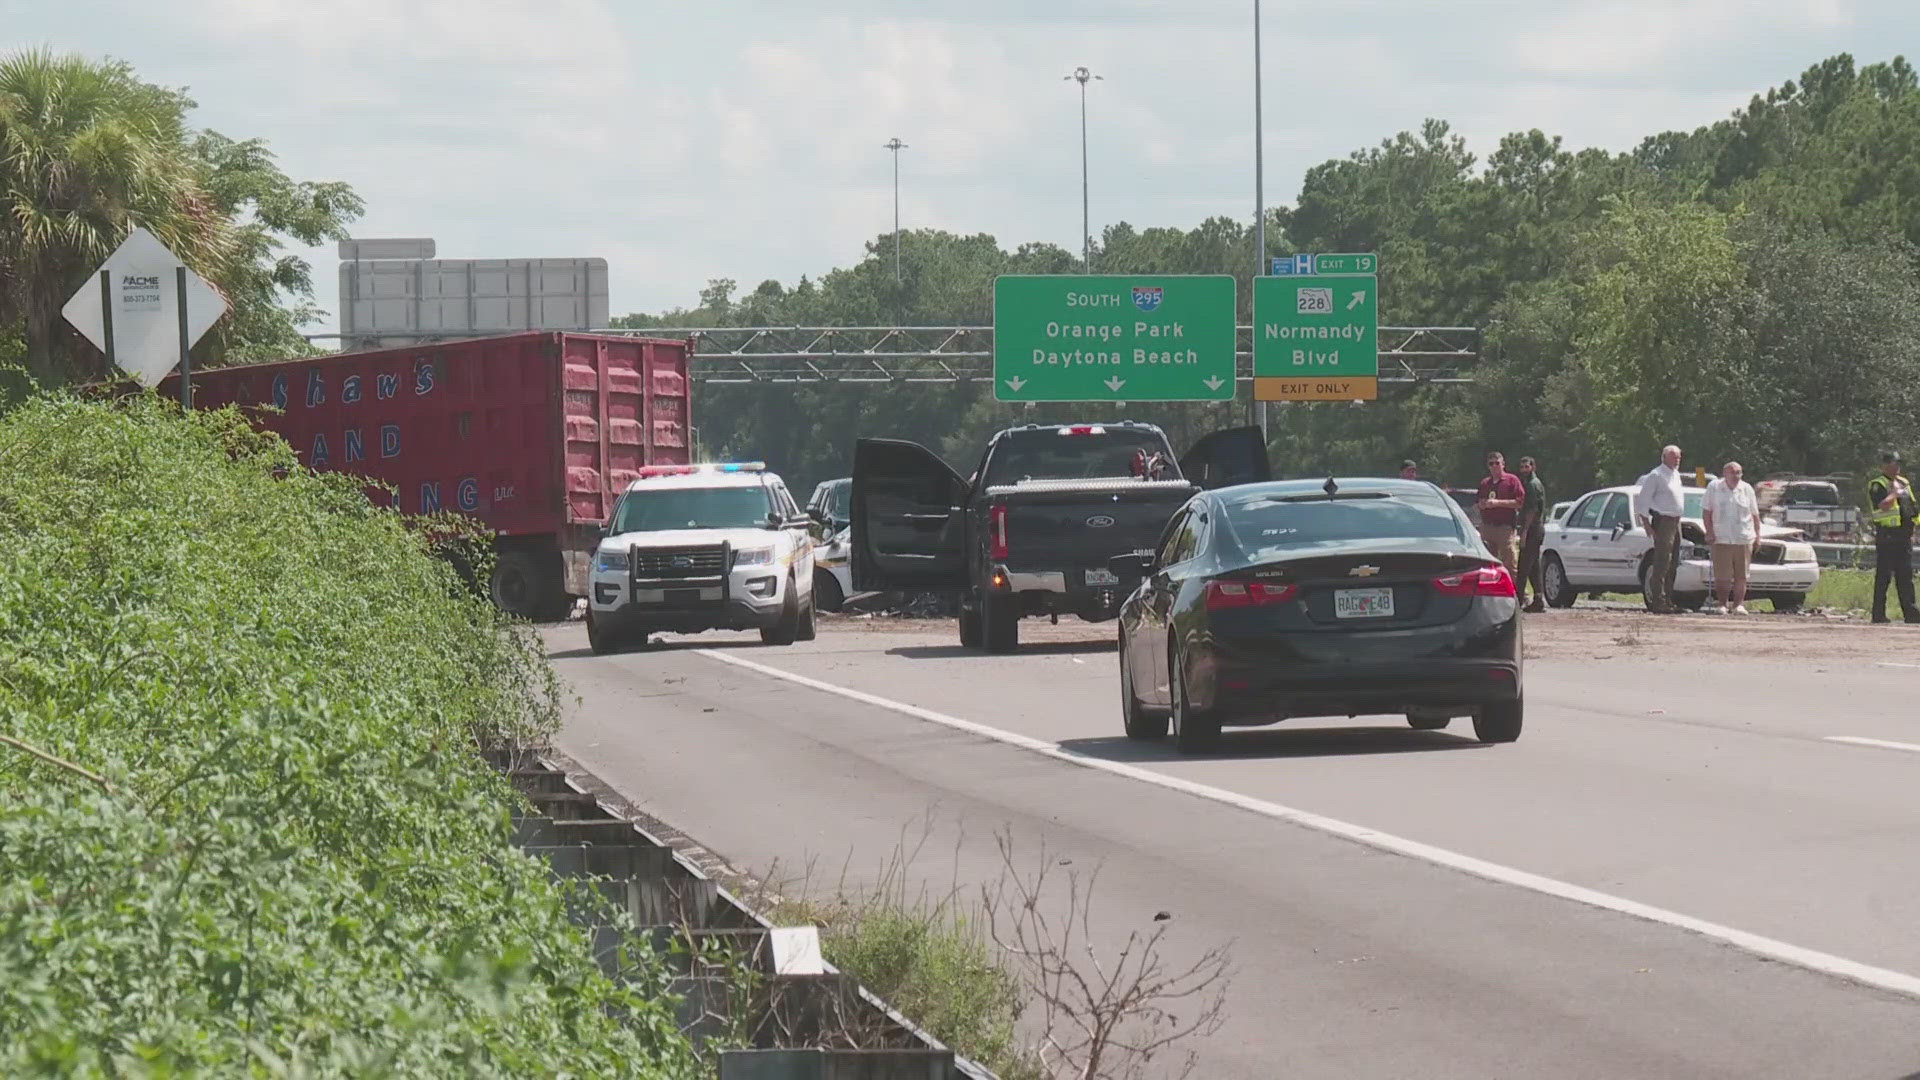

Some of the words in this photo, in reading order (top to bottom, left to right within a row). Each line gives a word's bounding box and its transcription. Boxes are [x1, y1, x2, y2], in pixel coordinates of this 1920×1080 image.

[1321, 260, 1344, 269] EXIT
[1356, 258, 1371, 270] 19
[1066, 292, 1120, 307] SOUTH
[1135, 293, 1161, 305] 295
[1299, 298, 1325, 310] 228
[1046, 321, 1122, 342] Orange
[1134, 321, 1184, 338] Park
[1265, 323, 1365, 342] Normandy
[1033, 349, 1121, 368] Daytona
[1133, 349, 1198, 364] Beach
[1292, 350, 1339, 365] Blvd
[1281, 384, 1309, 394] EXIT
[1316, 383, 1350, 394] ONLY
